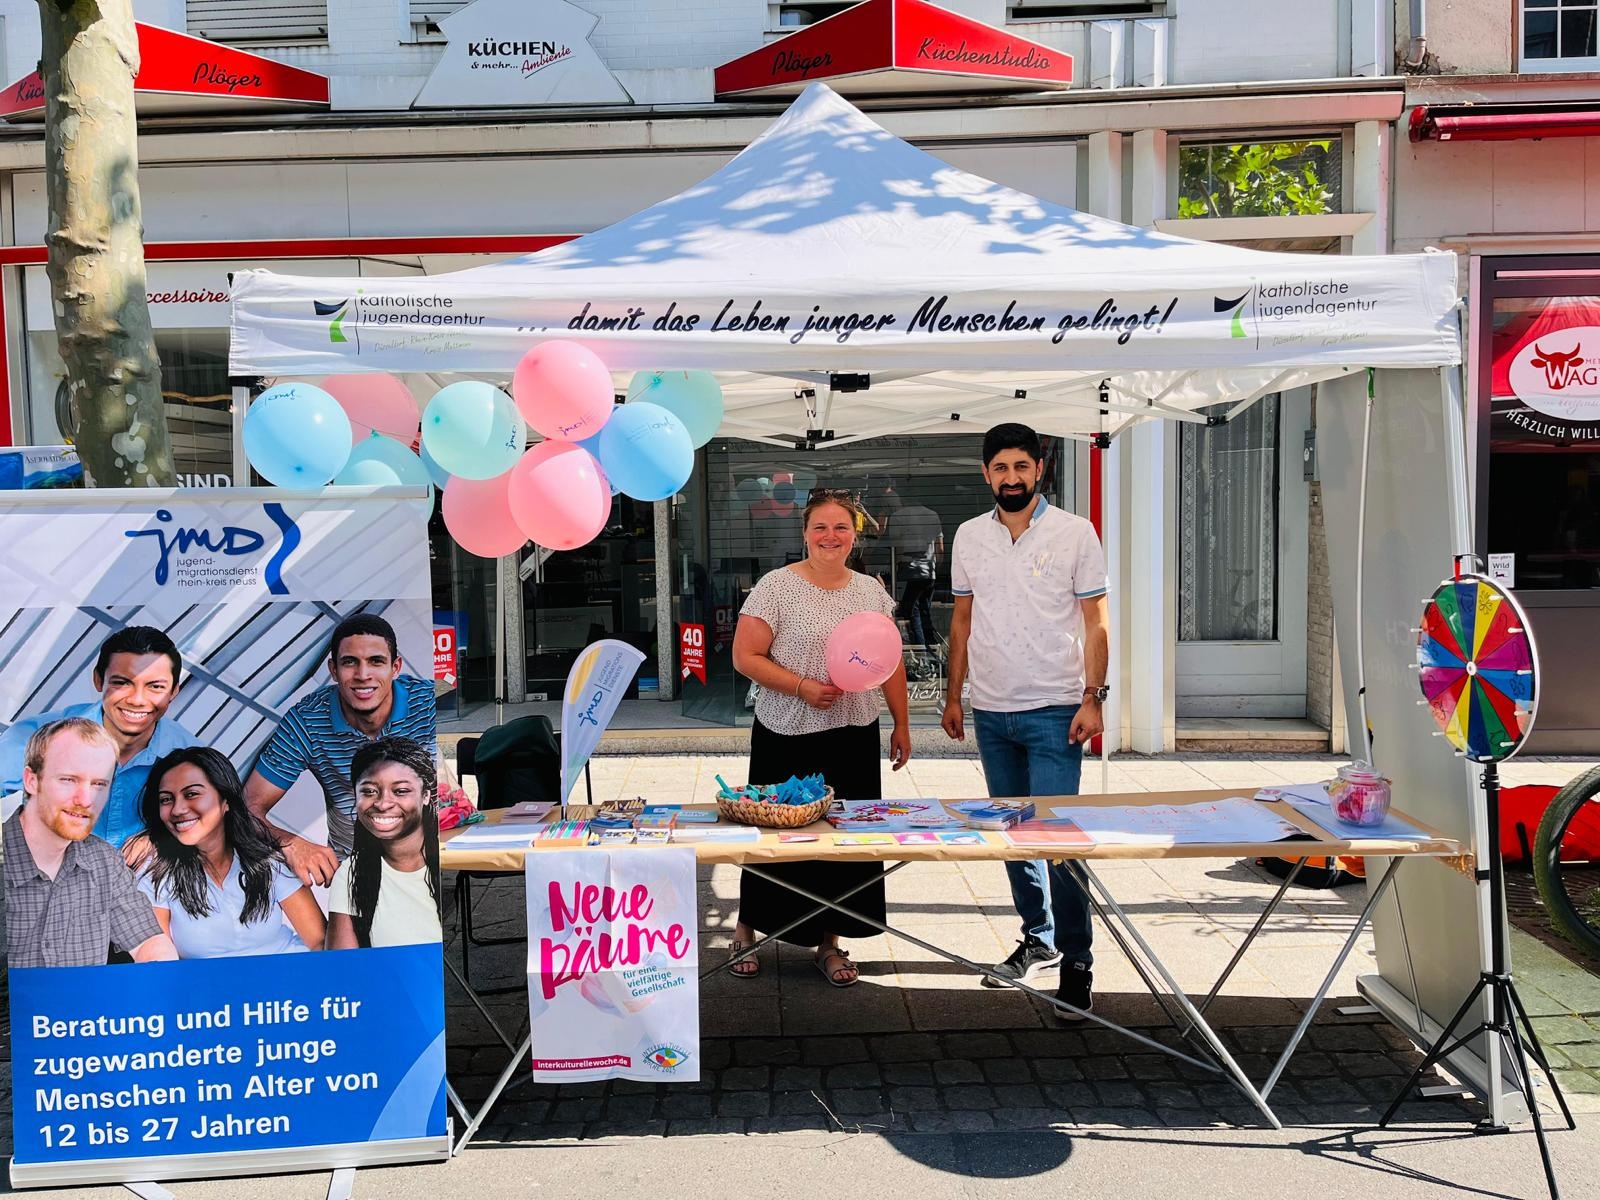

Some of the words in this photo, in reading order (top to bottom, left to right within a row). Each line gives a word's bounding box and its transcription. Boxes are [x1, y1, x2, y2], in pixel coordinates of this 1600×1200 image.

[468, 38, 555, 56] KÜCHEN
[918, 38, 1050, 69] Küchenstudio
[521, 44, 572, 73] Ambiente
[772, 50, 832, 76] Plöger
[192, 62, 263, 92] Plöger
[147, 288, 230, 304] ccessoire
[1258, 278, 1349, 299] katholische
[360, 293, 453, 308] katholische
[1259, 298, 1378, 321] jugendagentur
[363, 309, 486, 326] jugendagentur
[567, 302, 645, 331] damit
[653, 302, 700, 332] das
[710, 299, 791, 332] Leben
[790, 305, 896, 344] junger
[906, 296, 1046, 335] Menschen
[1050, 298, 1179, 344] gelingt!
[1546, 361, 1600, 388] WAG
[1506, 409, 1566, 438] HERZLICH
[1571, 428, 1600, 439] WILL
[176, 557, 216, 567] jugend-
[177, 567, 258, 579] migrationsdienst
[177, 578, 227, 587] rhein-kreis
[229, 578, 257, 586] neuss
[433, 633, 451, 652] 0
[683, 628, 703, 647] 40
[434, 654, 452, 663] HRE
[683, 648, 703, 657] JAHRE
[548, 881, 654, 932] Neue
[540, 923, 691, 1000] Räume
[623, 968, 636, 979] für
[638, 965, 657, 976] eine
[627, 971, 672, 988] vielfältige
[631, 977, 685, 997] Gesellschaft
[32, 1012, 165, 1038] Beratung
[176, 1005, 231, 1030] und
[243, 1000, 309, 1026] Hilfe
[320, 997, 361, 1020] für
[34, 1044, 242, 1079] zugewanderte
[256, 1038, 337, 1066] junge
[537, 1057, 628, 1069] interkulturellewoche.de
[35, 1084, 186, 1112] Menschen
[197, 1080, 232, 1102] im
[244, 1074, 315, 1099] Alter
[325, 1070, 378, 1093] von
[39, 1124, 77, 1148] 12
[88, 1121, 129, 1145] bis
[142, 1117, 179, 1142] 27
[191, 1113, 290, 1139] Jahren
